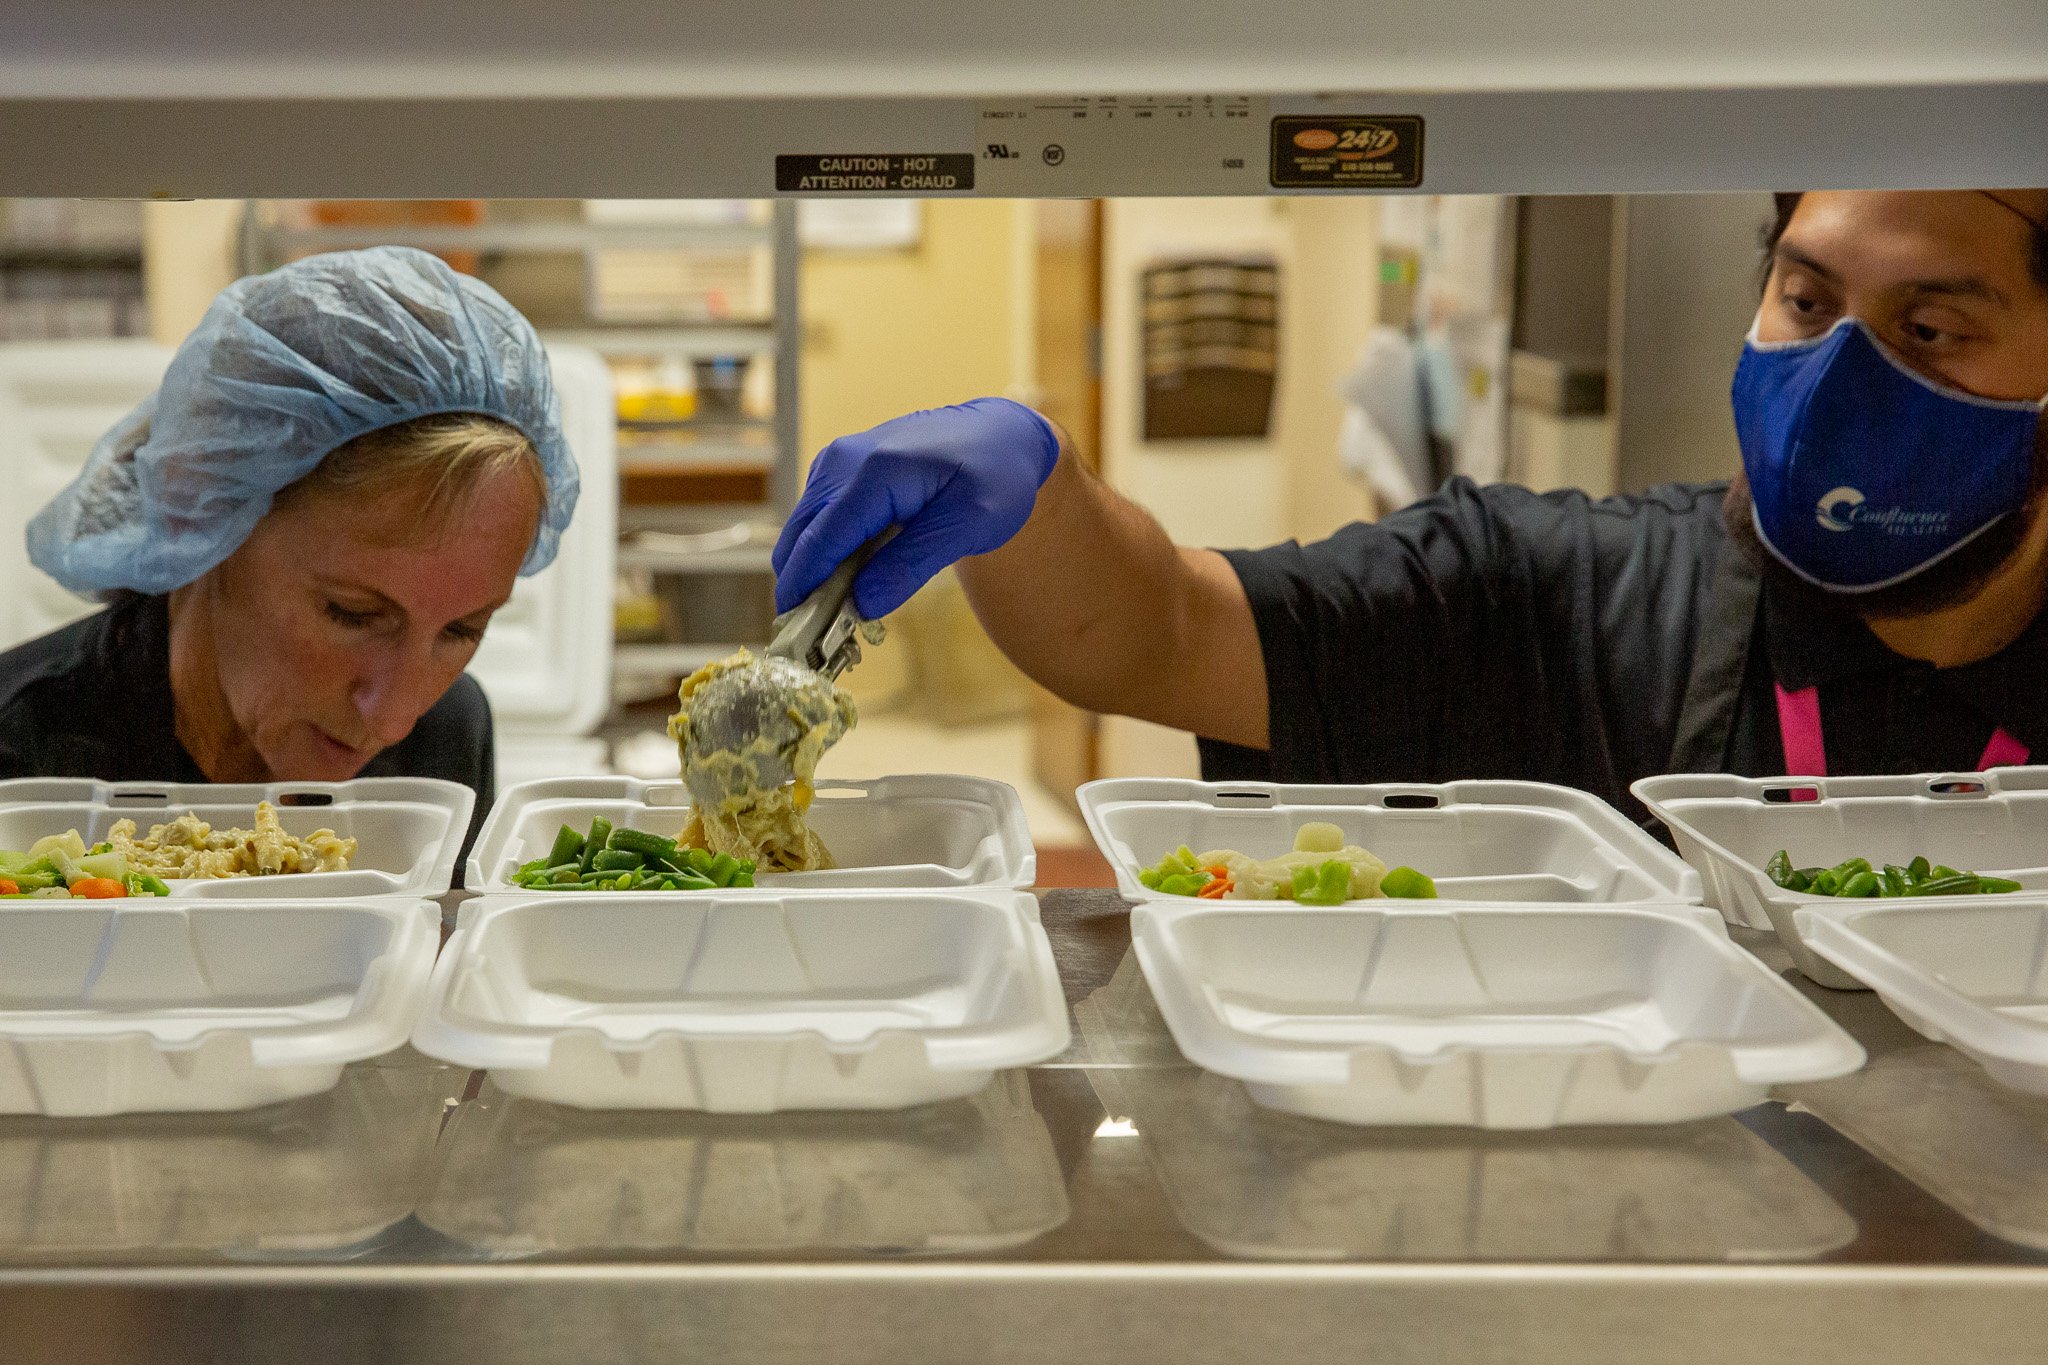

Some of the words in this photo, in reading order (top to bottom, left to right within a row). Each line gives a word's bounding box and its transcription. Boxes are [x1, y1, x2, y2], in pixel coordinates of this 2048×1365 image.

[819, 158, 889, 171] CAUTION
[903, 158, 936, 171] HOT
[800, 175, 887, 189] ATTENTION
[900, 175, 956, 189] CHAUD
